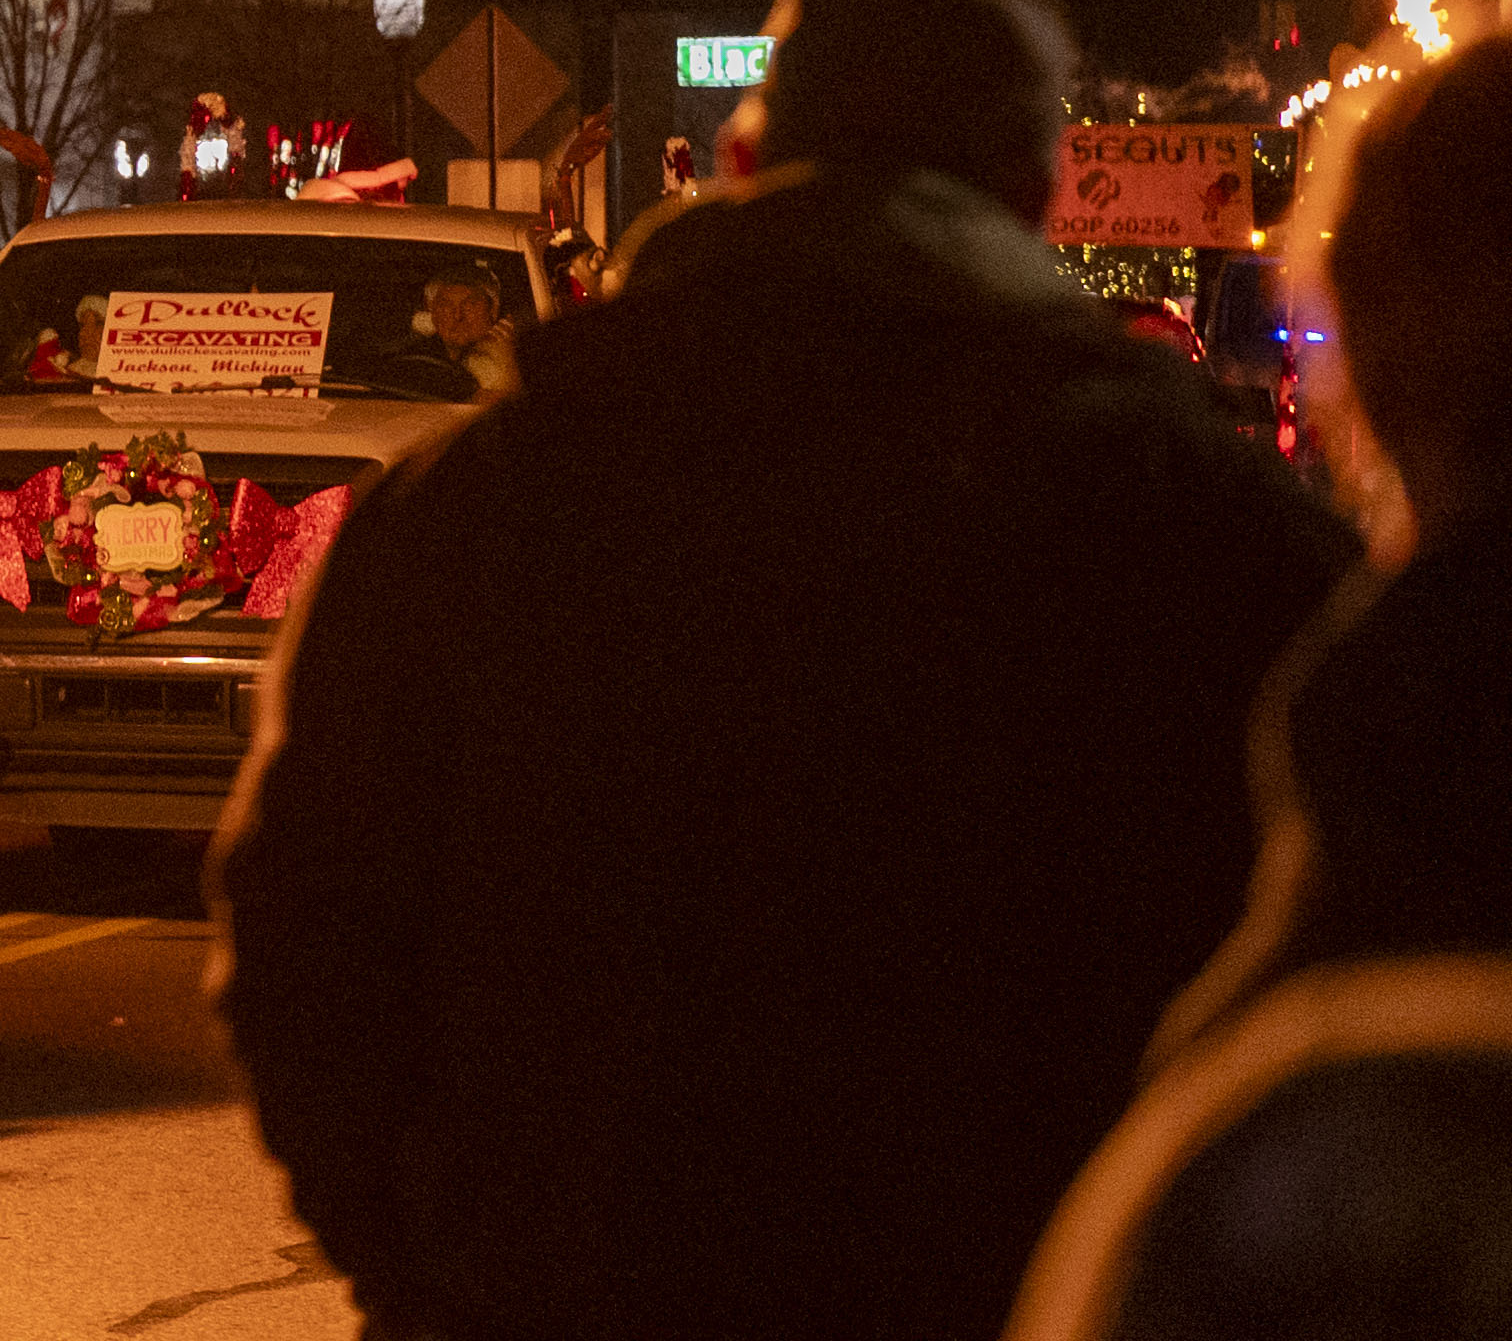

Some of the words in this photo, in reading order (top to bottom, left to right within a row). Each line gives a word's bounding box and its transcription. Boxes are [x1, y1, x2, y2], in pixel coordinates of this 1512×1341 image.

[1071, 135, 1238, 165] SCOUTS
[1051, 217, 1104, 233] OOP
[115, 330, 313, 347] EXCAVATING
[210, 359, 306, 375] Michigan
